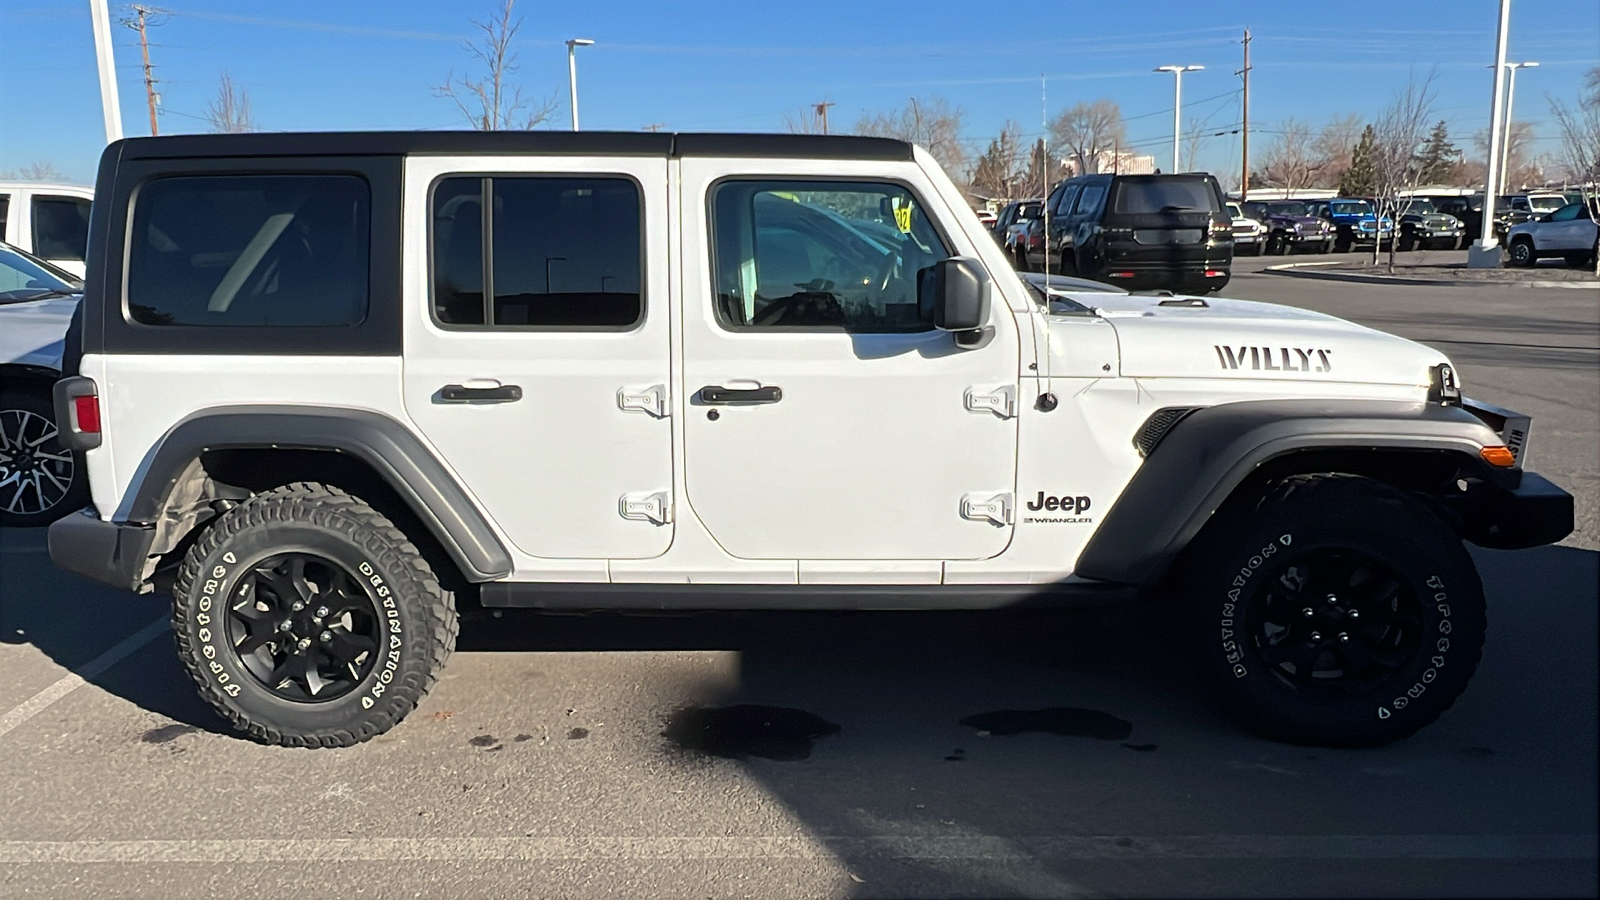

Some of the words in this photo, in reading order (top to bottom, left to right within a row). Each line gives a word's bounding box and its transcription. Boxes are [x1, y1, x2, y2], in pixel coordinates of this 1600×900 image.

[1214, 345, 1331, 373] WILLYS
[1027, 491, 1091, 515] Jeep
[359, 561, 402, 698] DESTINATION
[1221, 542, 1277, 678] DESTINATION
